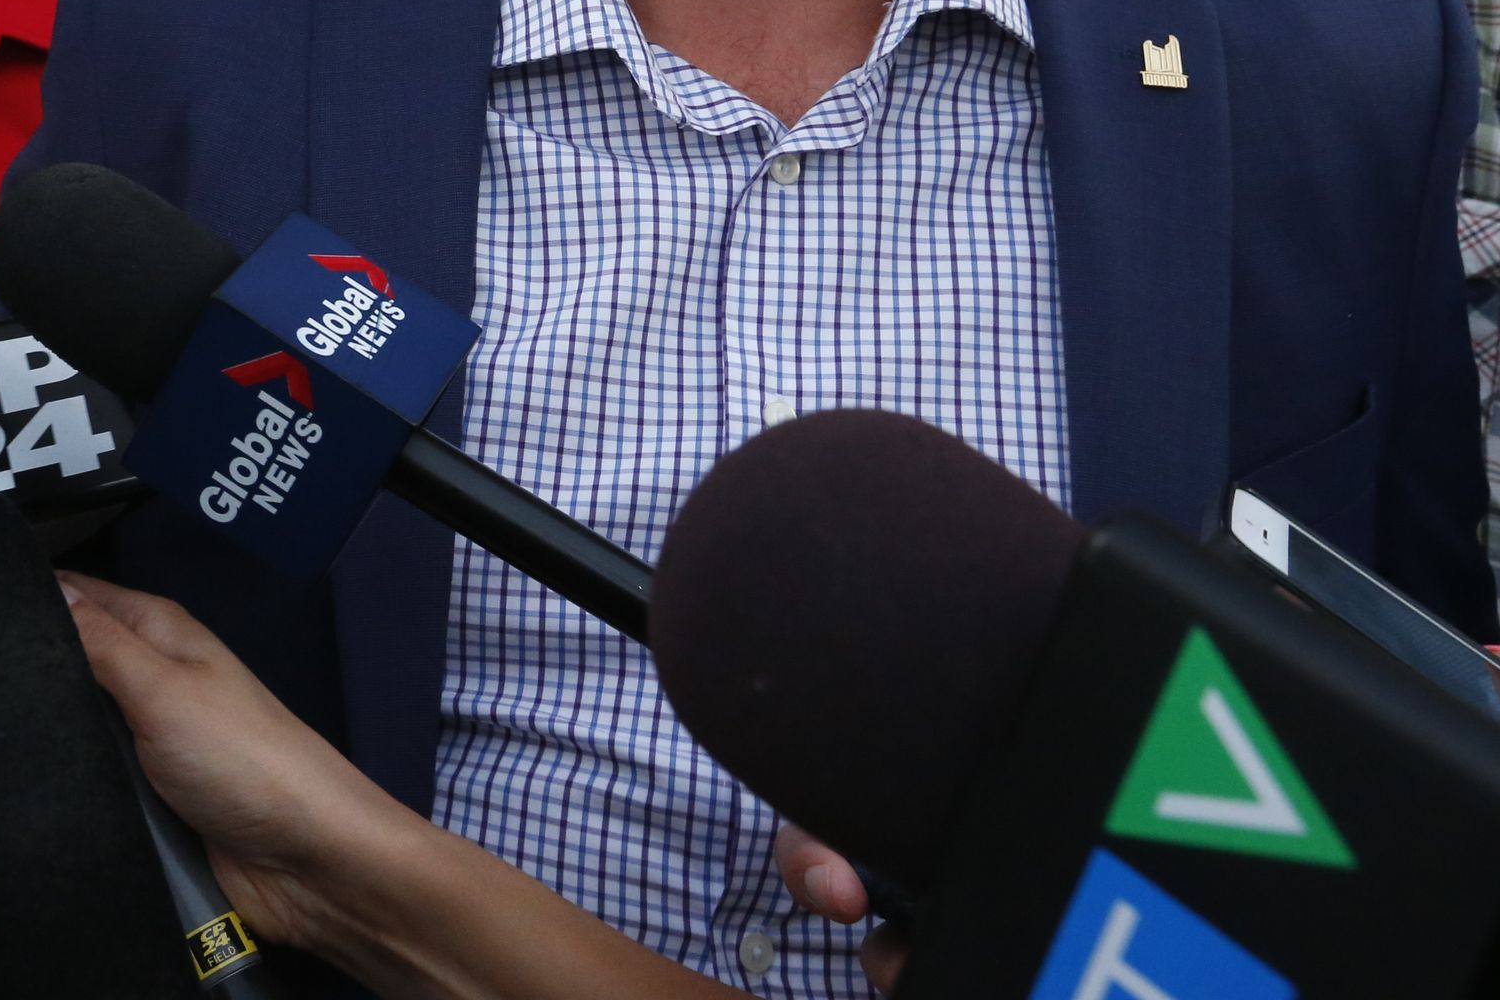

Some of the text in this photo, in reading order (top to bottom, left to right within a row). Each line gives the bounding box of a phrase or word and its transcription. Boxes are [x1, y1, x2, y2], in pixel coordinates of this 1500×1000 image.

[295, 274, 379, 357] Global
[347, 300, 406, 360] NEWS
[199, 390, 296, 523] Global
[252, 414, 323, 515] NEWS
[200, 921, 227, 943] CP
[202, 932, 231, 957] 24
[207, 945, 237, 968] FIELD
